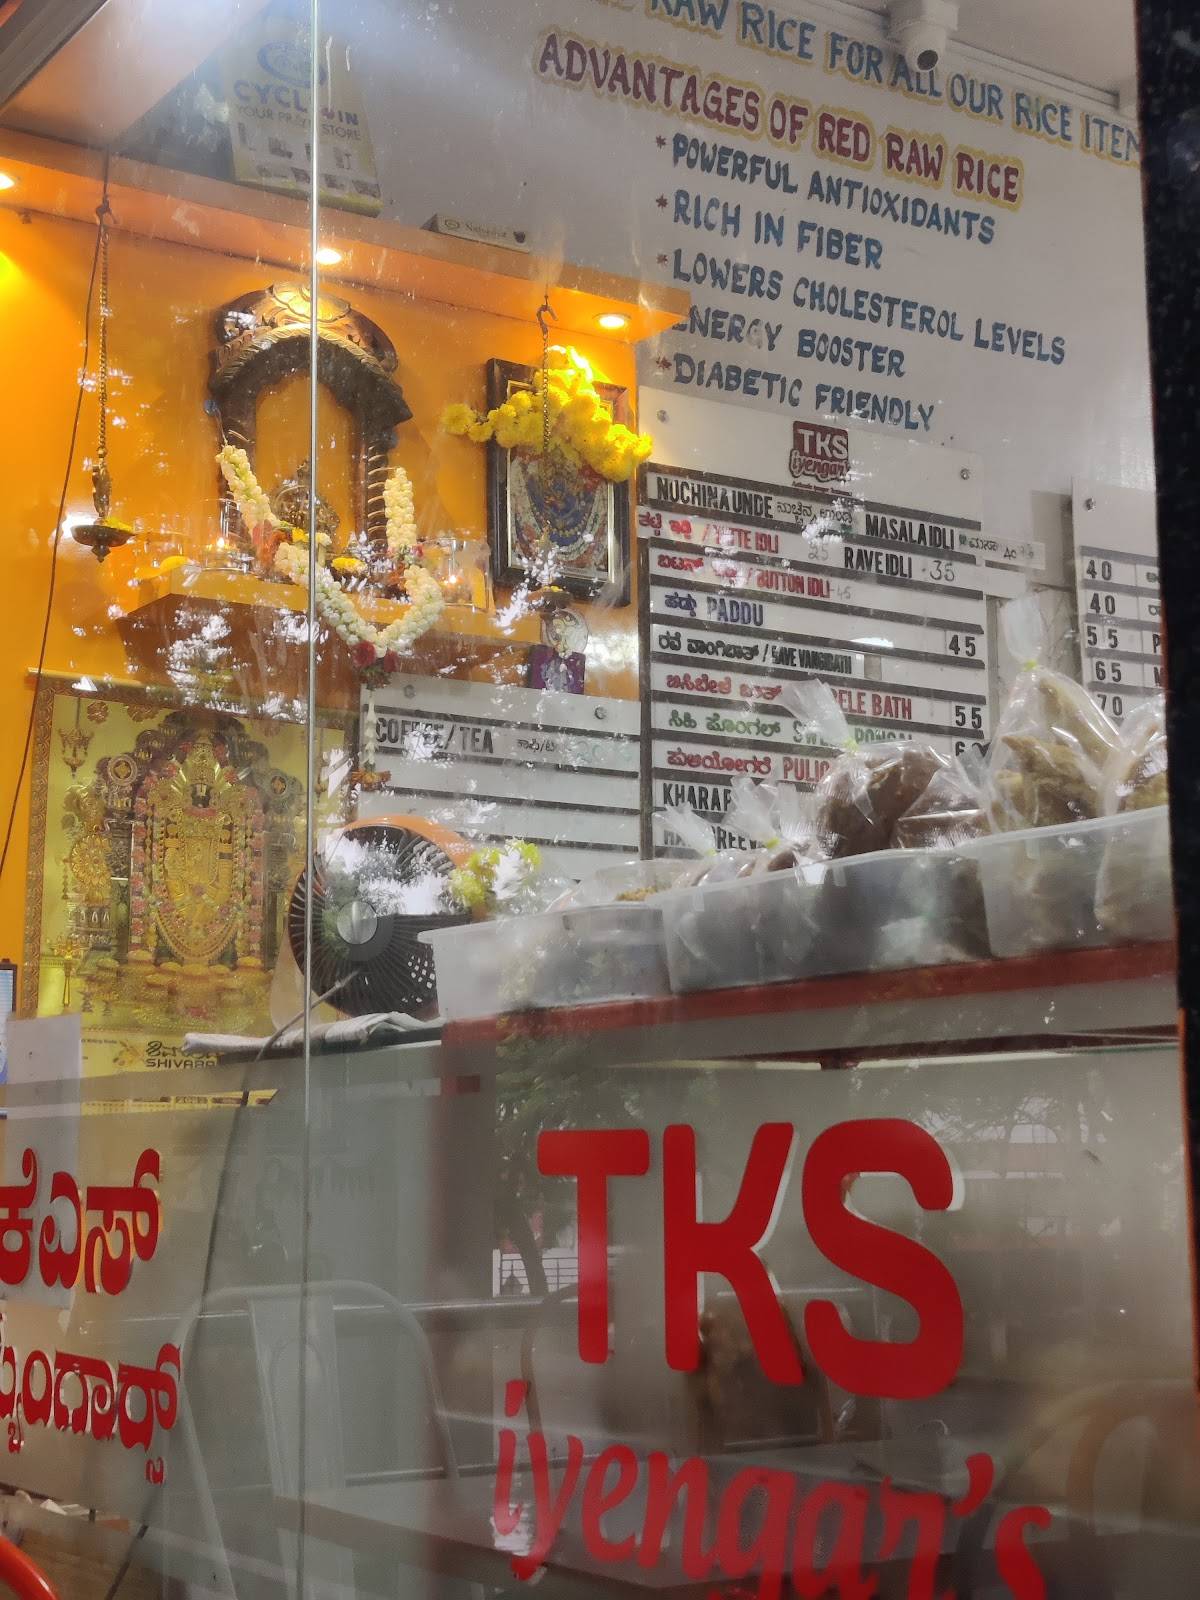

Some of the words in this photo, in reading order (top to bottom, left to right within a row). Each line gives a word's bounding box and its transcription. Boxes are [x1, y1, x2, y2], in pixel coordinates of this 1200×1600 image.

[741, 1, 817, 60] RICE
[829, 31, 883, 83] FOR
[890, 55, 942, 97] ALL
[951, 73, 1004, 120] OUR
[1015, 92, 1073, 142] RICE
[539, 32, 761, 131] ADVANTAGES
[770, 100, 808, 144] OF
[818, 112, 871, 162] RED
[884, 132, 944, 181] RAW
[956, 152, 1019, 203] RICE
[672, 132, 799, 194] POWERFUL
[807, 170, 996, 245] ANTIOXIDANTS
[673, 189, 741, 238] RICH
[754, 209, 785, 247] IN
[797, 219, 883, 270] FIBER
[673, 248, 784, 301] LOWERS
[793, 276, 963, 342] CHOLESTEROL
[973, 318, 1066, 365] LEVELS
[797, 328, 906, 378] BOOSTER
[673, 352, 802, 408] DIABETIC
[815, 383, 934, 432] FRIENDLY
[798, 428, 848, 460] TKS
[755, 531, 779, 554] IDLI
[807, 576, 830, 599] IDLI
[1086, 559, 1112, 581] 40
[706, 596, 764, 626] PADDU
[949, 634, 976, 657] 45
[1090, 592, 1116, 615] 40
[1086, 625, 1118, 648] 55
[1095, 660, 1122, 683] 65
[871, 693, 912, 720] BATH
[955, 705, 982, 729] 55
[1097, 694, 1123, 716] 70
[537, 1118, 964, 1400] TKS
[492, 1380, 1052, 1600] iyengar's
